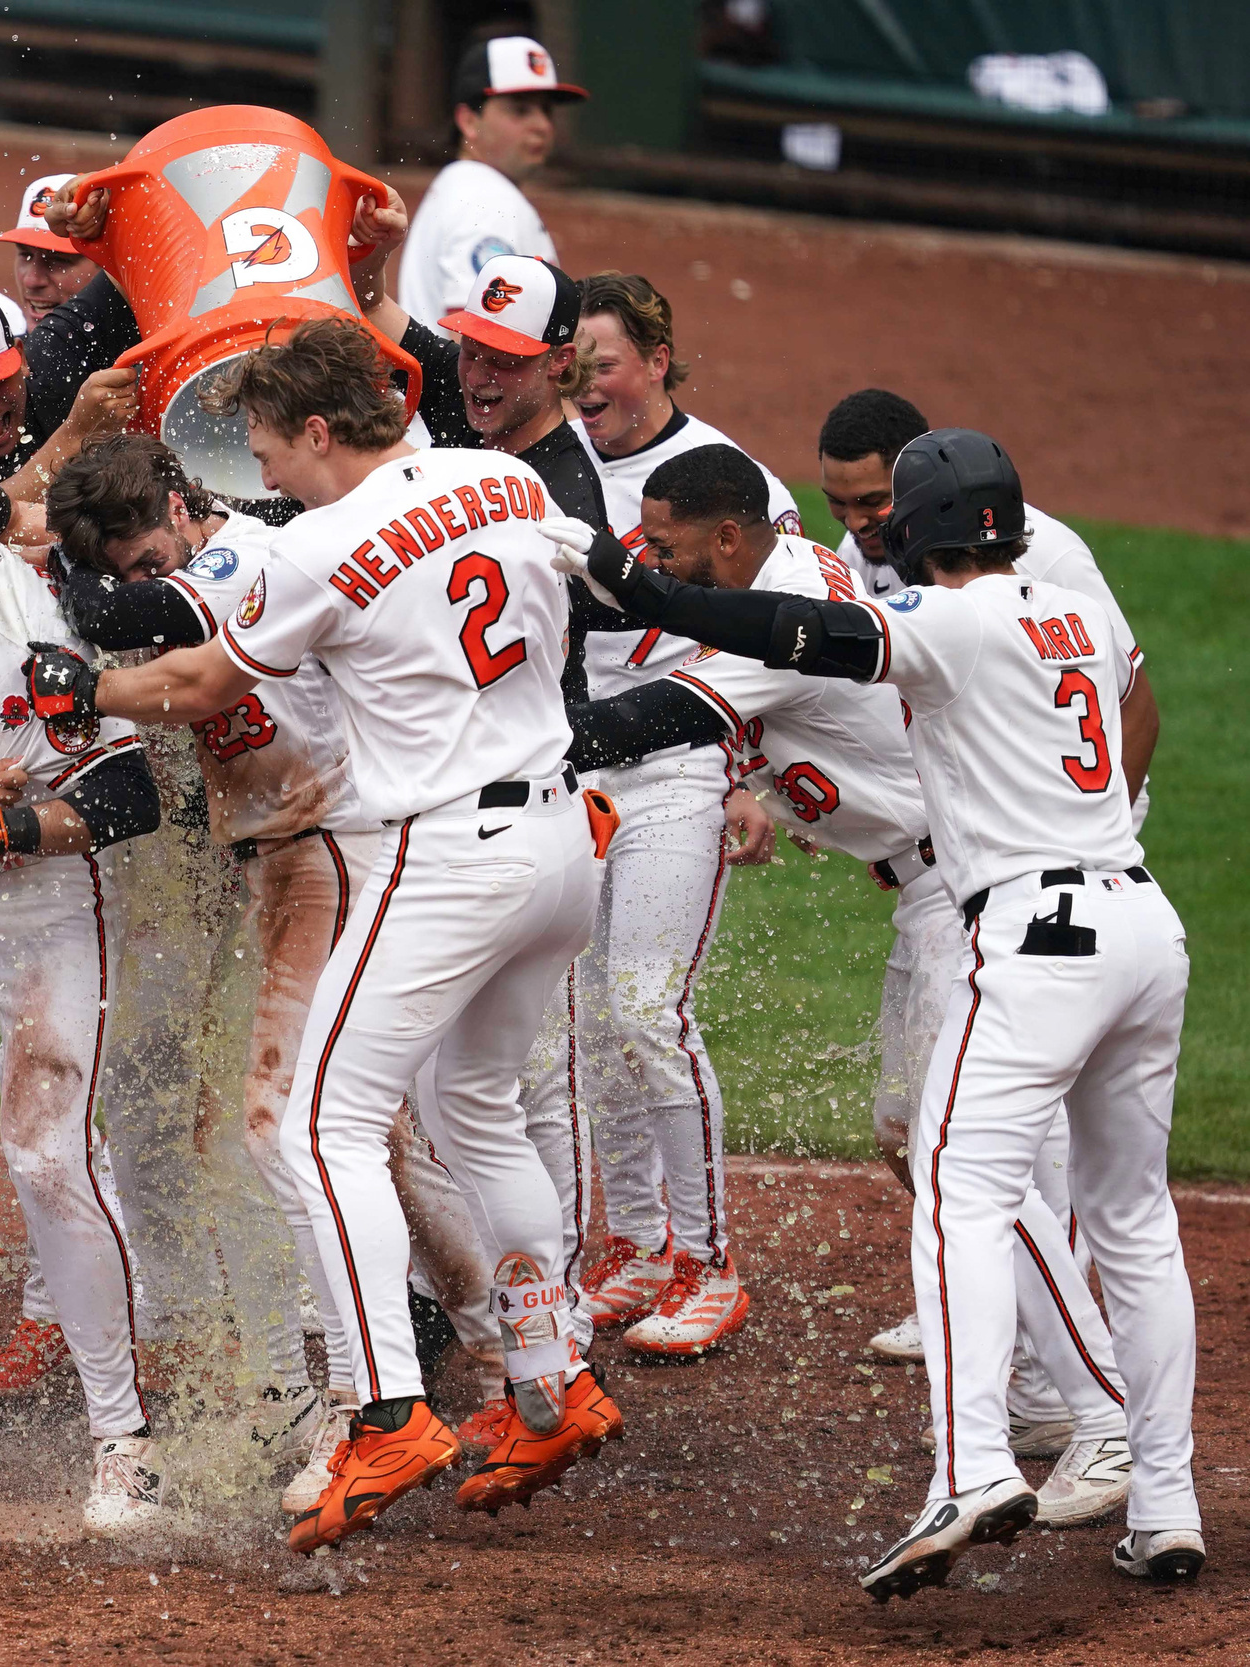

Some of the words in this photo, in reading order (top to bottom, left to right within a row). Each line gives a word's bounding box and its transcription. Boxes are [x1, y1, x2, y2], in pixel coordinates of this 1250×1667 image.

[983, 508, 995, 528] 3
[328, 475, 546, 611] HENDERSON
[621, 553, 636, 580] JAX
[446, 550, 528, 691] 2
[1018, 612, 1096, 661] WARD
[788, 625, 807, 662] JAX
[189, 692, 278, 764] 23
[1054, 668, 1113, 794] 3
[523, 1283, 565, 1309] GUN
[567, 1337, 582, 1363] 2
